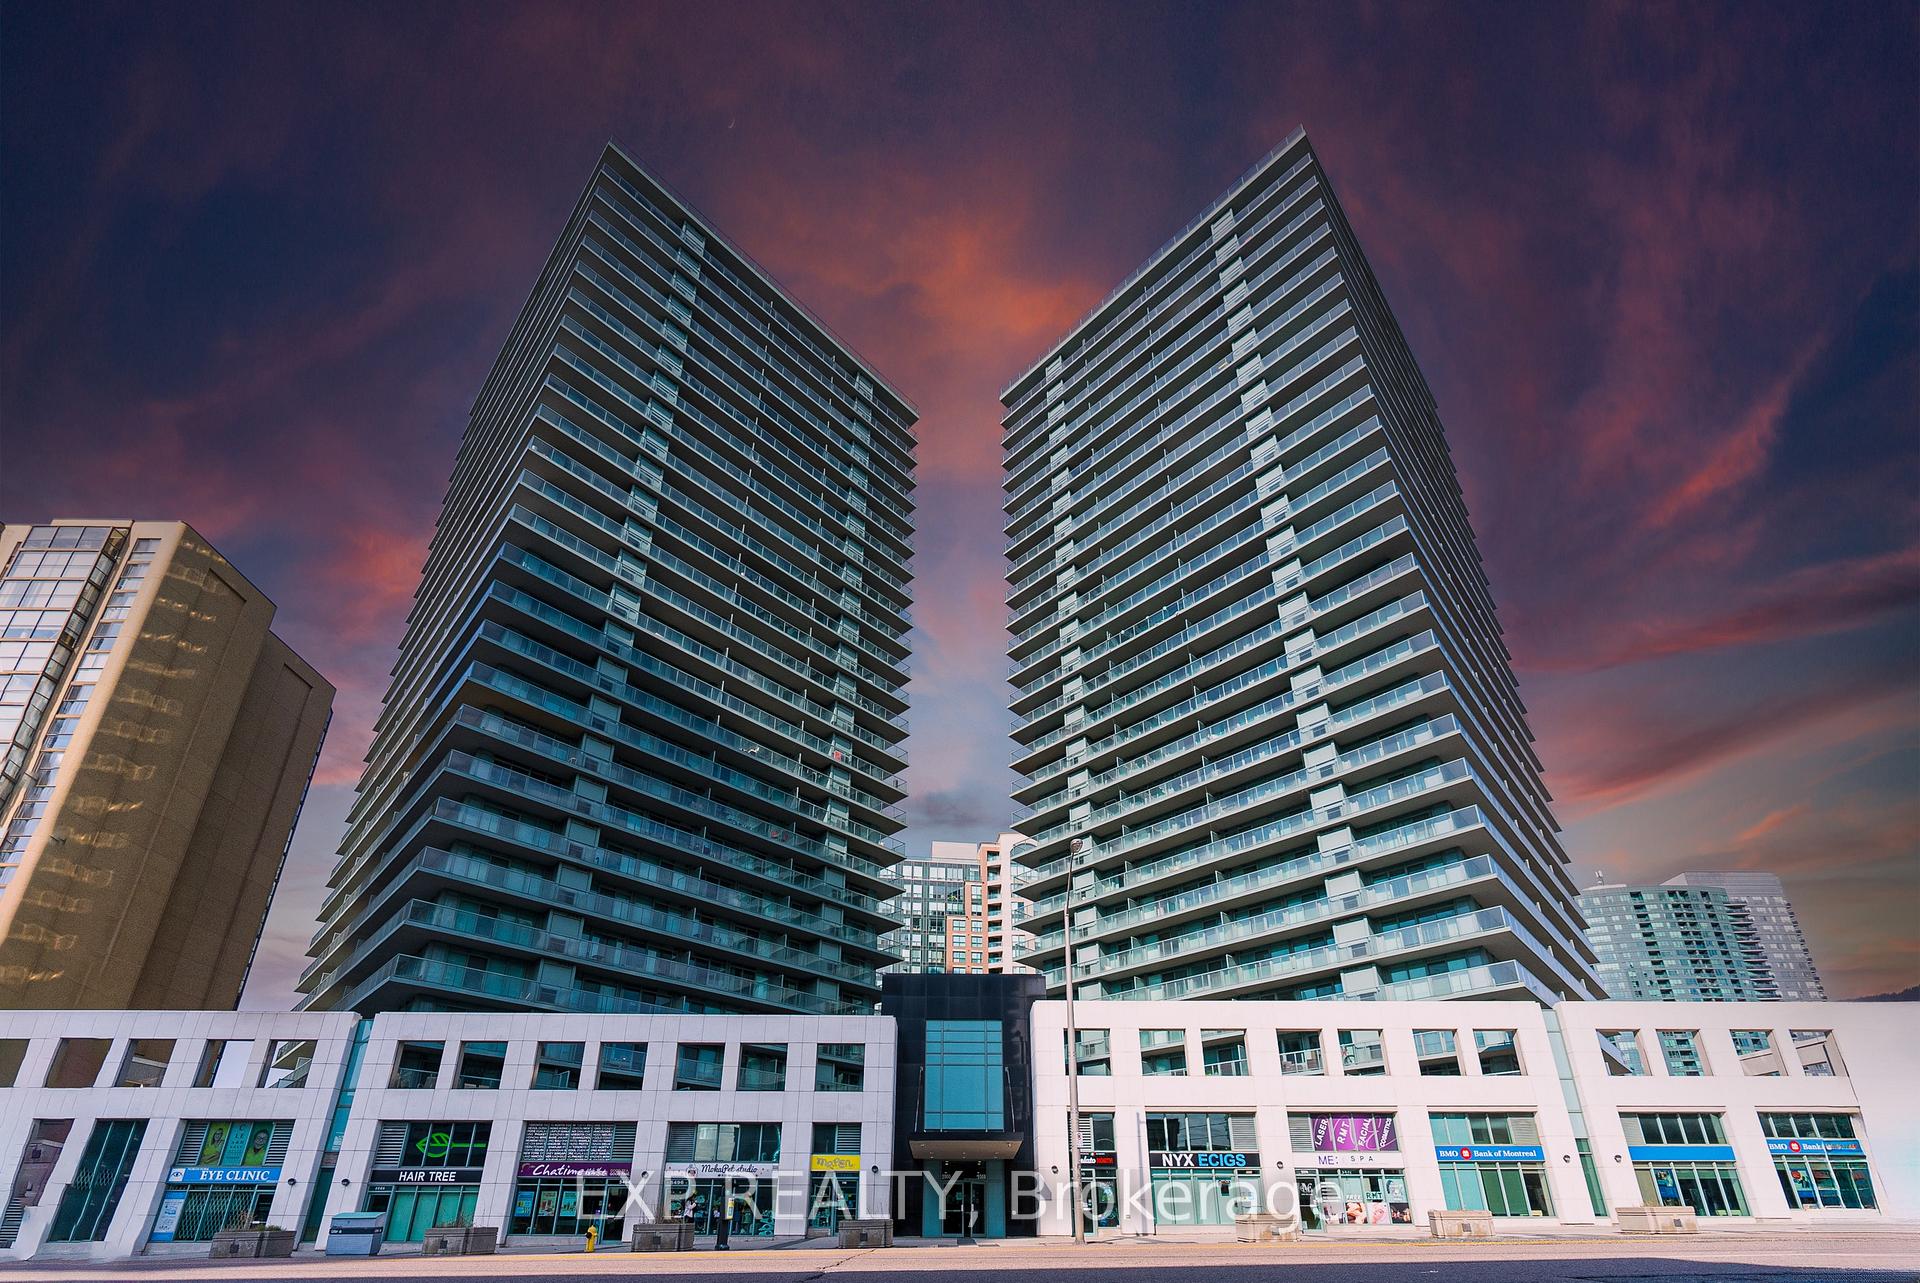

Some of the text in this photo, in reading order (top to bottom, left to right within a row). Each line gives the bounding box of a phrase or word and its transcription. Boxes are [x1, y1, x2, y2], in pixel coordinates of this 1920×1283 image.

[1315, 1119, 1329, 1146] LASER
[1337, 1121, 1351, 1144] RMT
[1358, 1118, 1372, 1147] FACIAL
[1162, 1153, 1246, 1166] NYX ECIGS
[1503, 1149, 1537, 1157] Montreal
[199, 1170, 270, 1181] EYE CLINIC
[532, 1163, 584, 1176] Chatime
[398, 1171, 457, 1182] HAIR TREE
